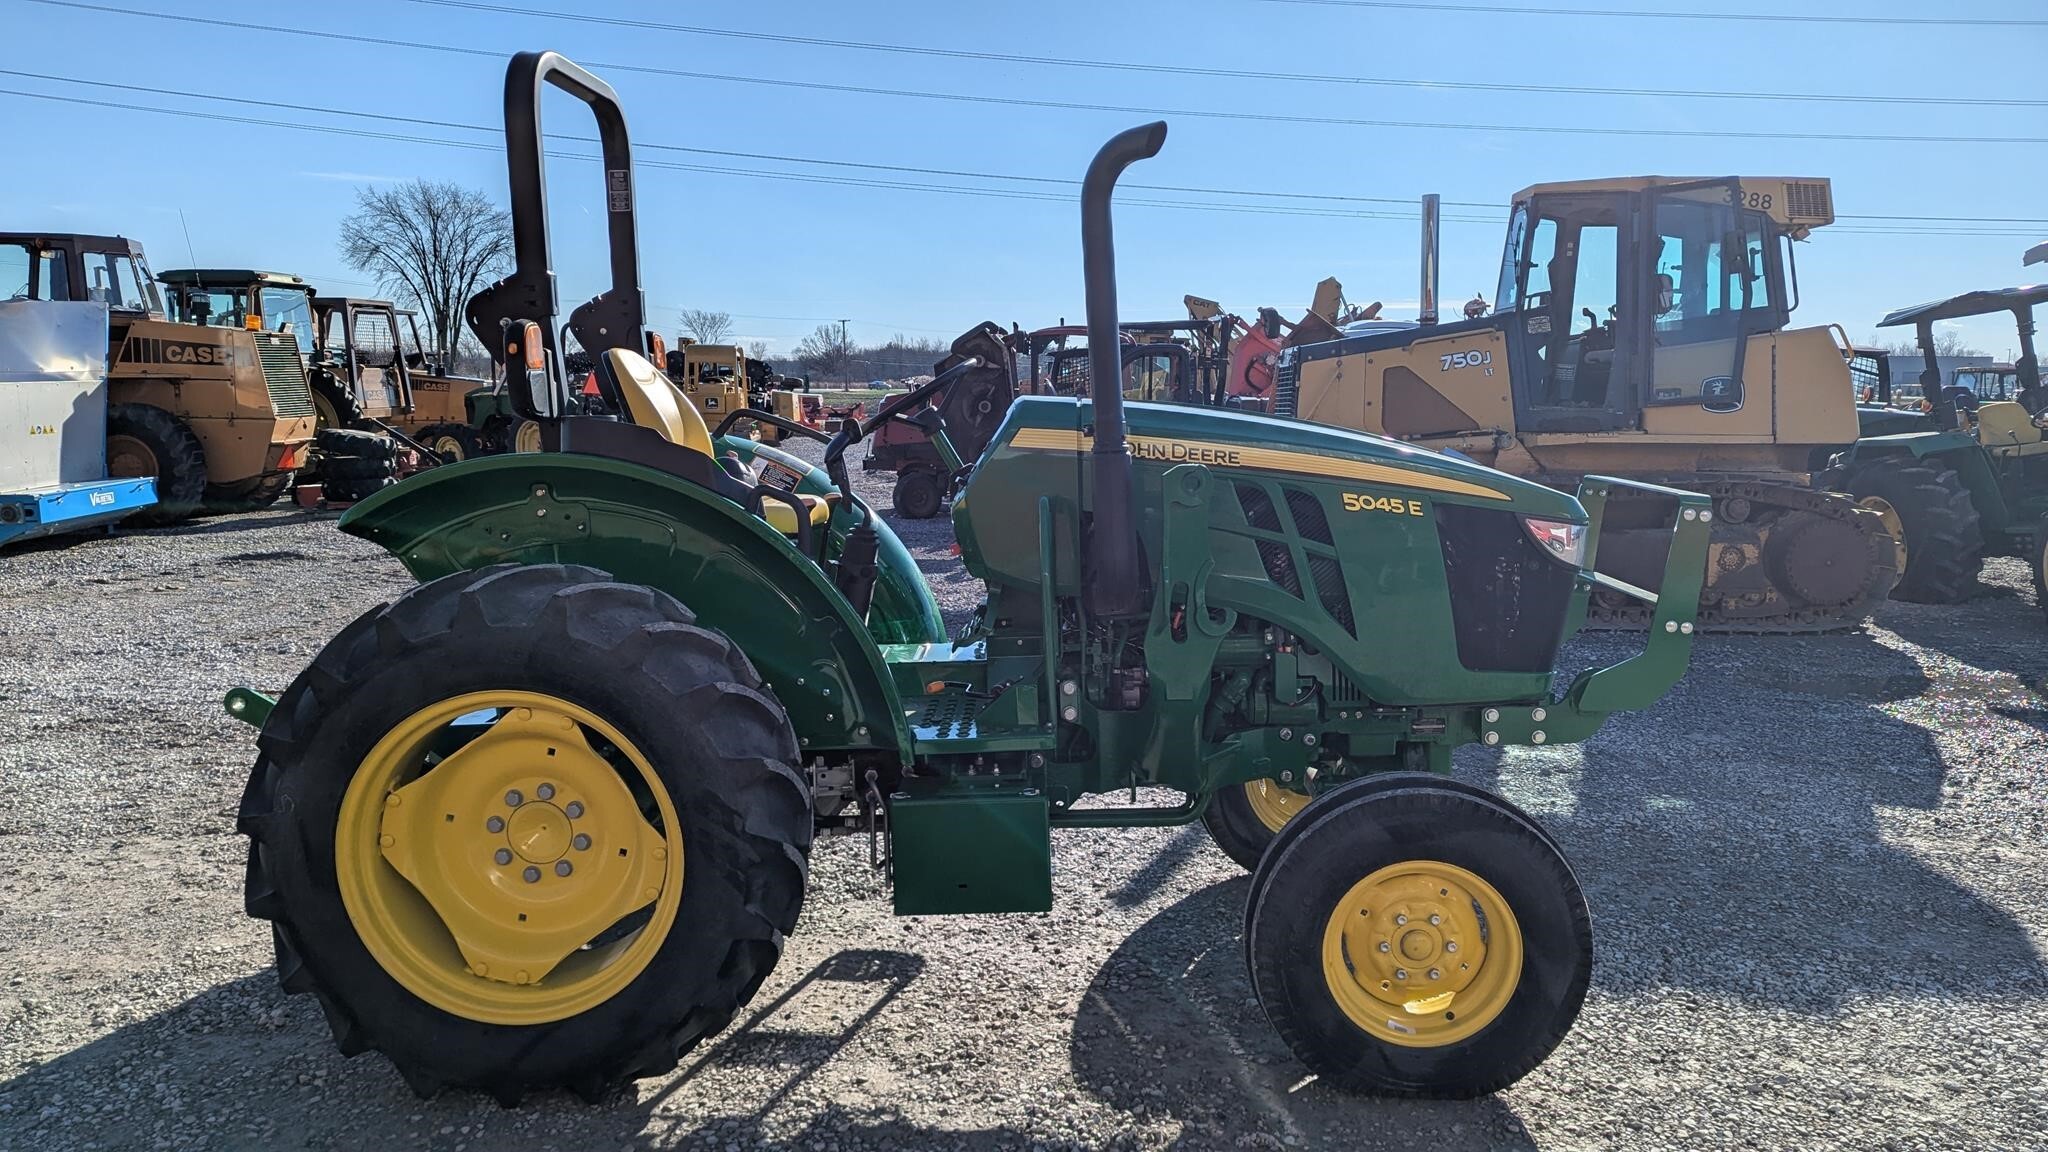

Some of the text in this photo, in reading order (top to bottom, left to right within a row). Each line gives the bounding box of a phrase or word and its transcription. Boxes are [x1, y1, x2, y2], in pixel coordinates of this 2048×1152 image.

[1193, 300, 1210, 308] CAT
[166, 345, 227, 363] CASE
[1441, 350, 1491, 371] 750J
[1484, 368, 1494, 376] LT
[424, 382, 449, 391] CASE
[1127, 442, 1240, 465] OHN DEERE
[1342, 492, 1424, 516] 5045 E
